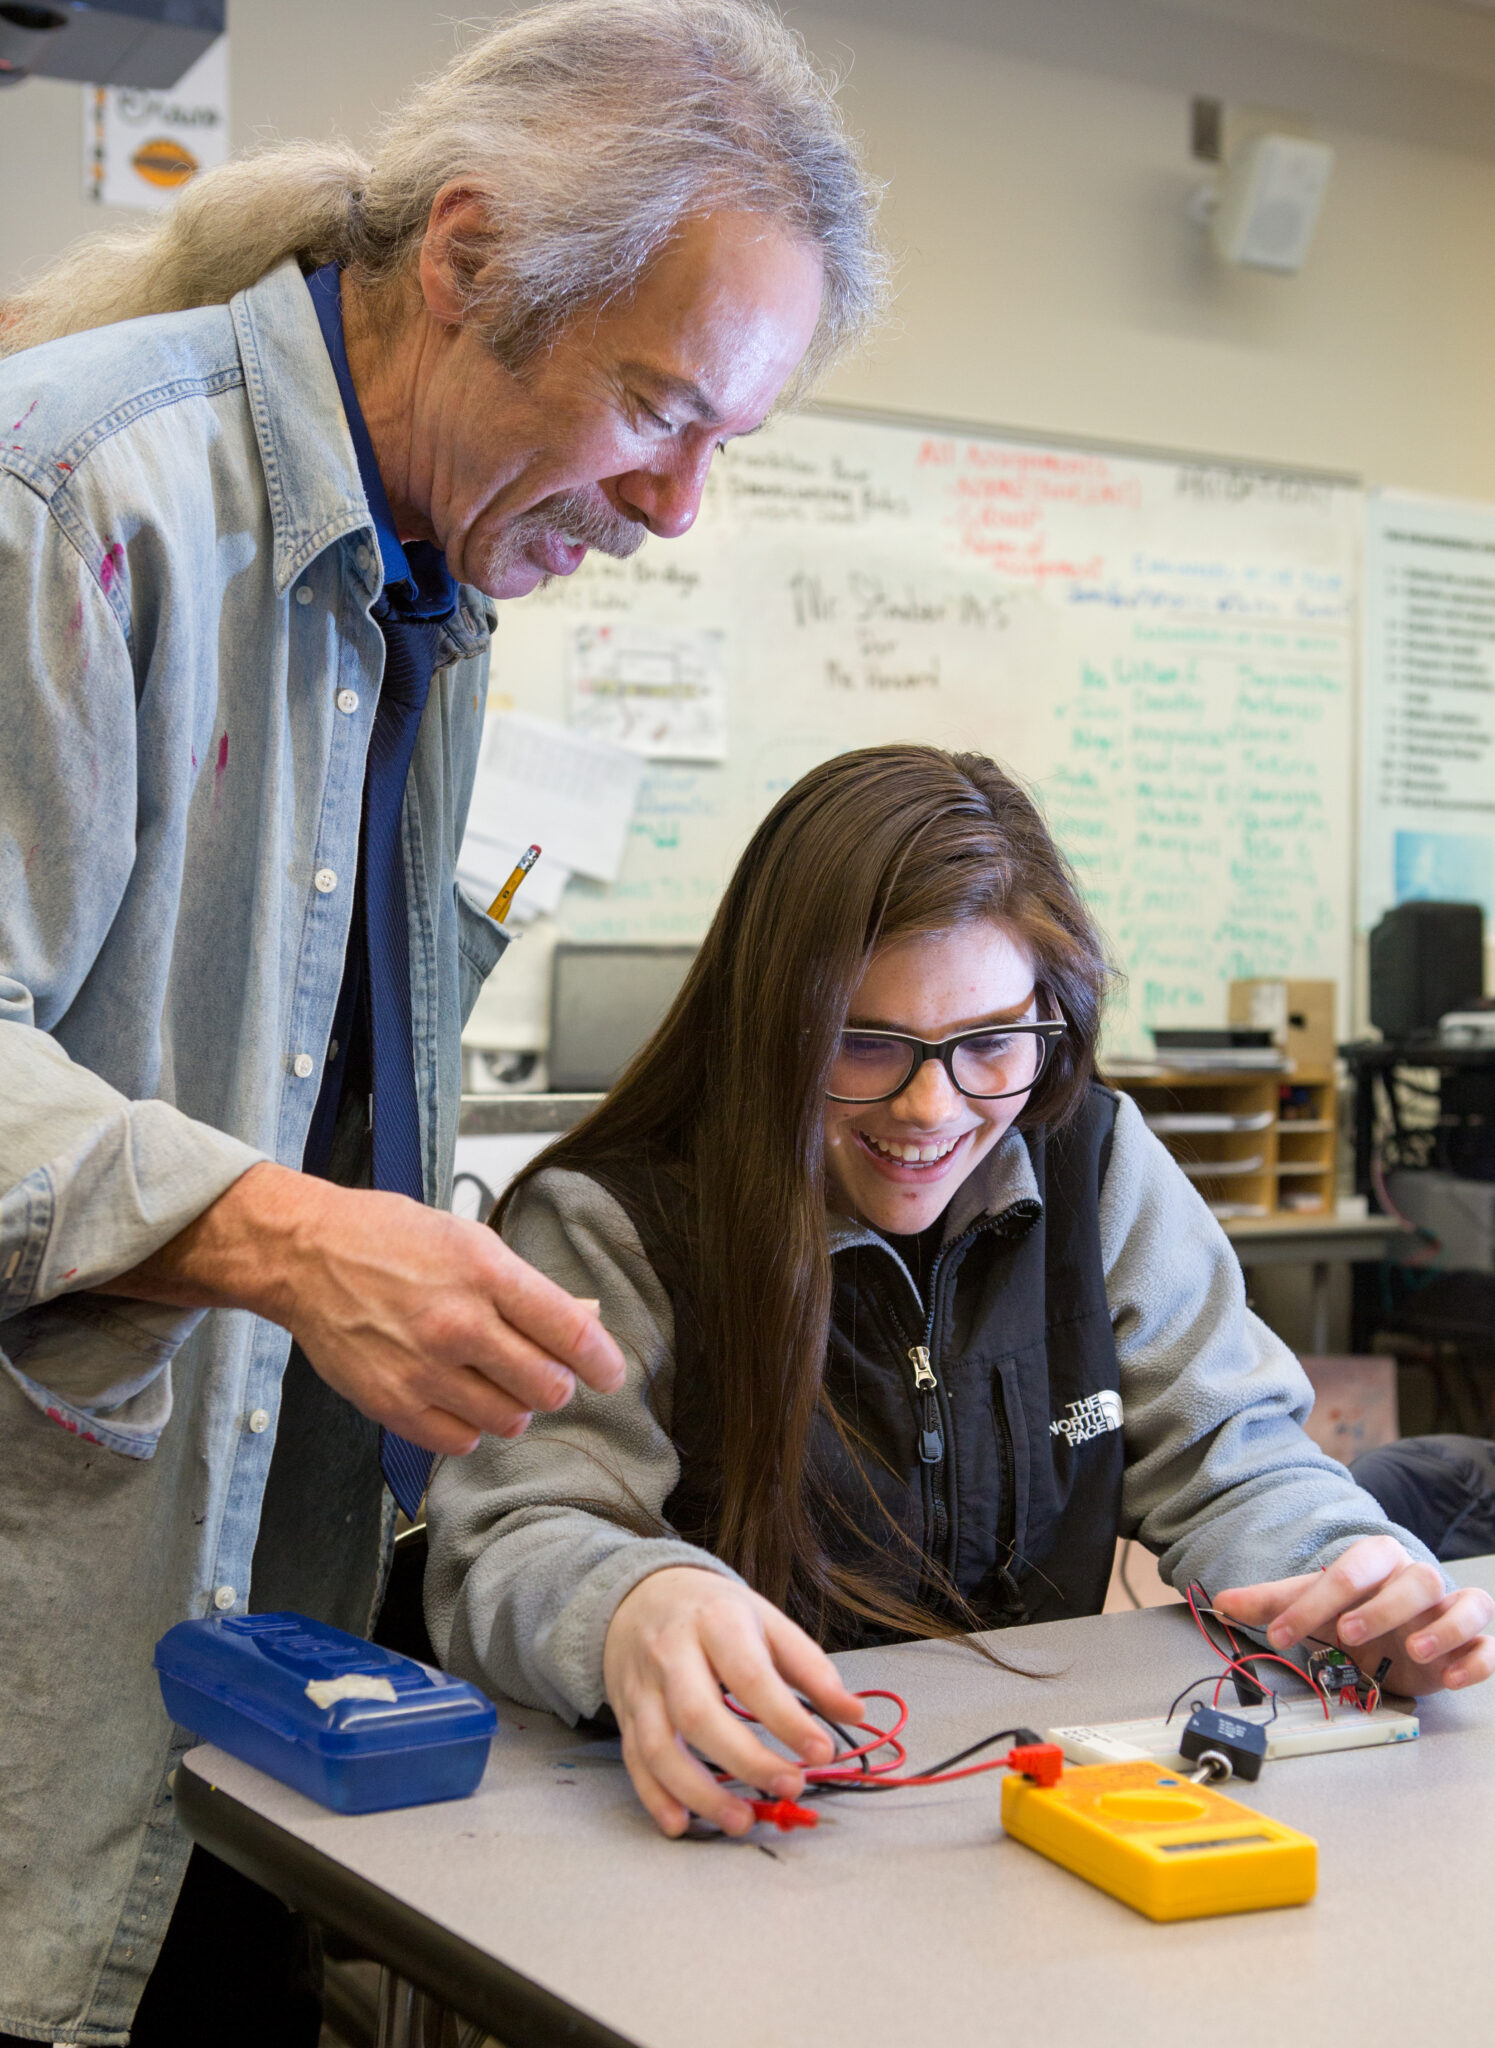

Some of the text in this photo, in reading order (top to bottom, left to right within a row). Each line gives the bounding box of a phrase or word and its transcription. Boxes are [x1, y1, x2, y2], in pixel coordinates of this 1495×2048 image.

[1065, 1394, 1100, 1416] THE
[1049, 1407, 1105, 1437] NORTH
[1065, 1420, 1108, 1447] FACE
